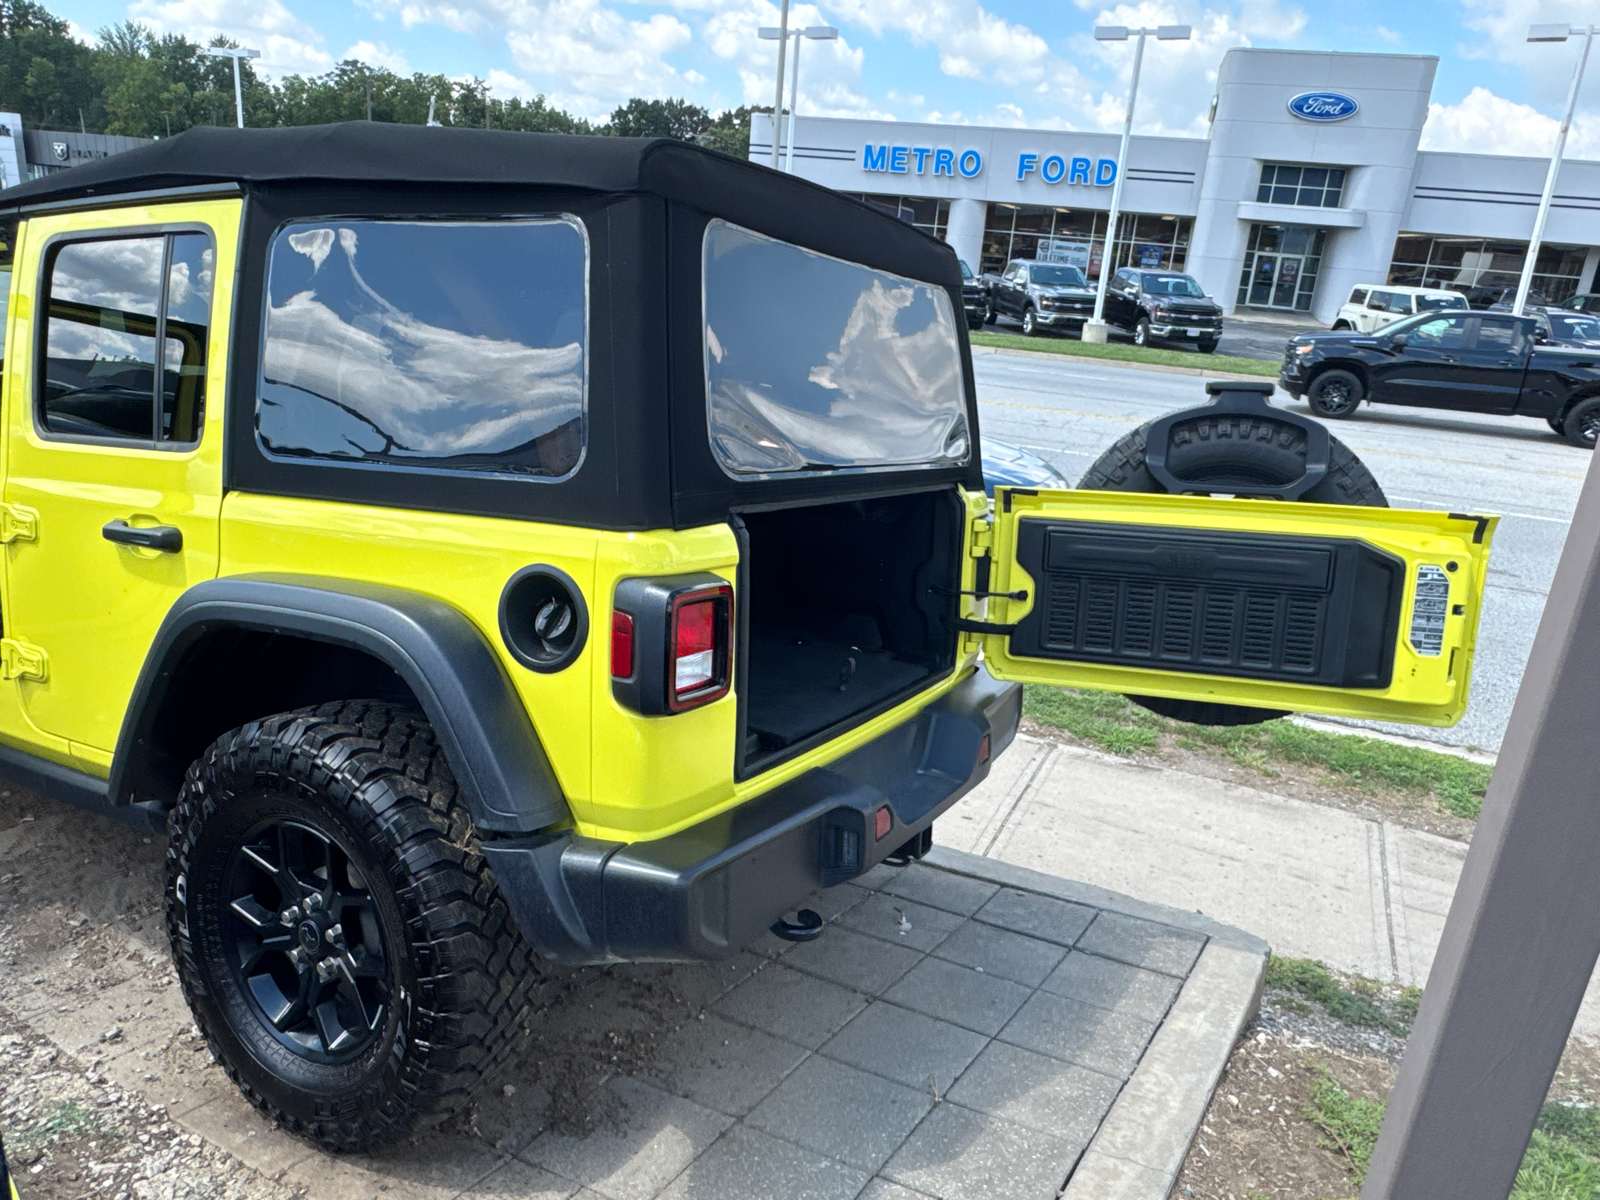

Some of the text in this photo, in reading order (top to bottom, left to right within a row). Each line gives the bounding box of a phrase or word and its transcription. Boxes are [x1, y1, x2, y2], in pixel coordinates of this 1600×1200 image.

[1302, 96, 1345, 115] Ford
[861, 144, 1118, 187] METRO FORD
